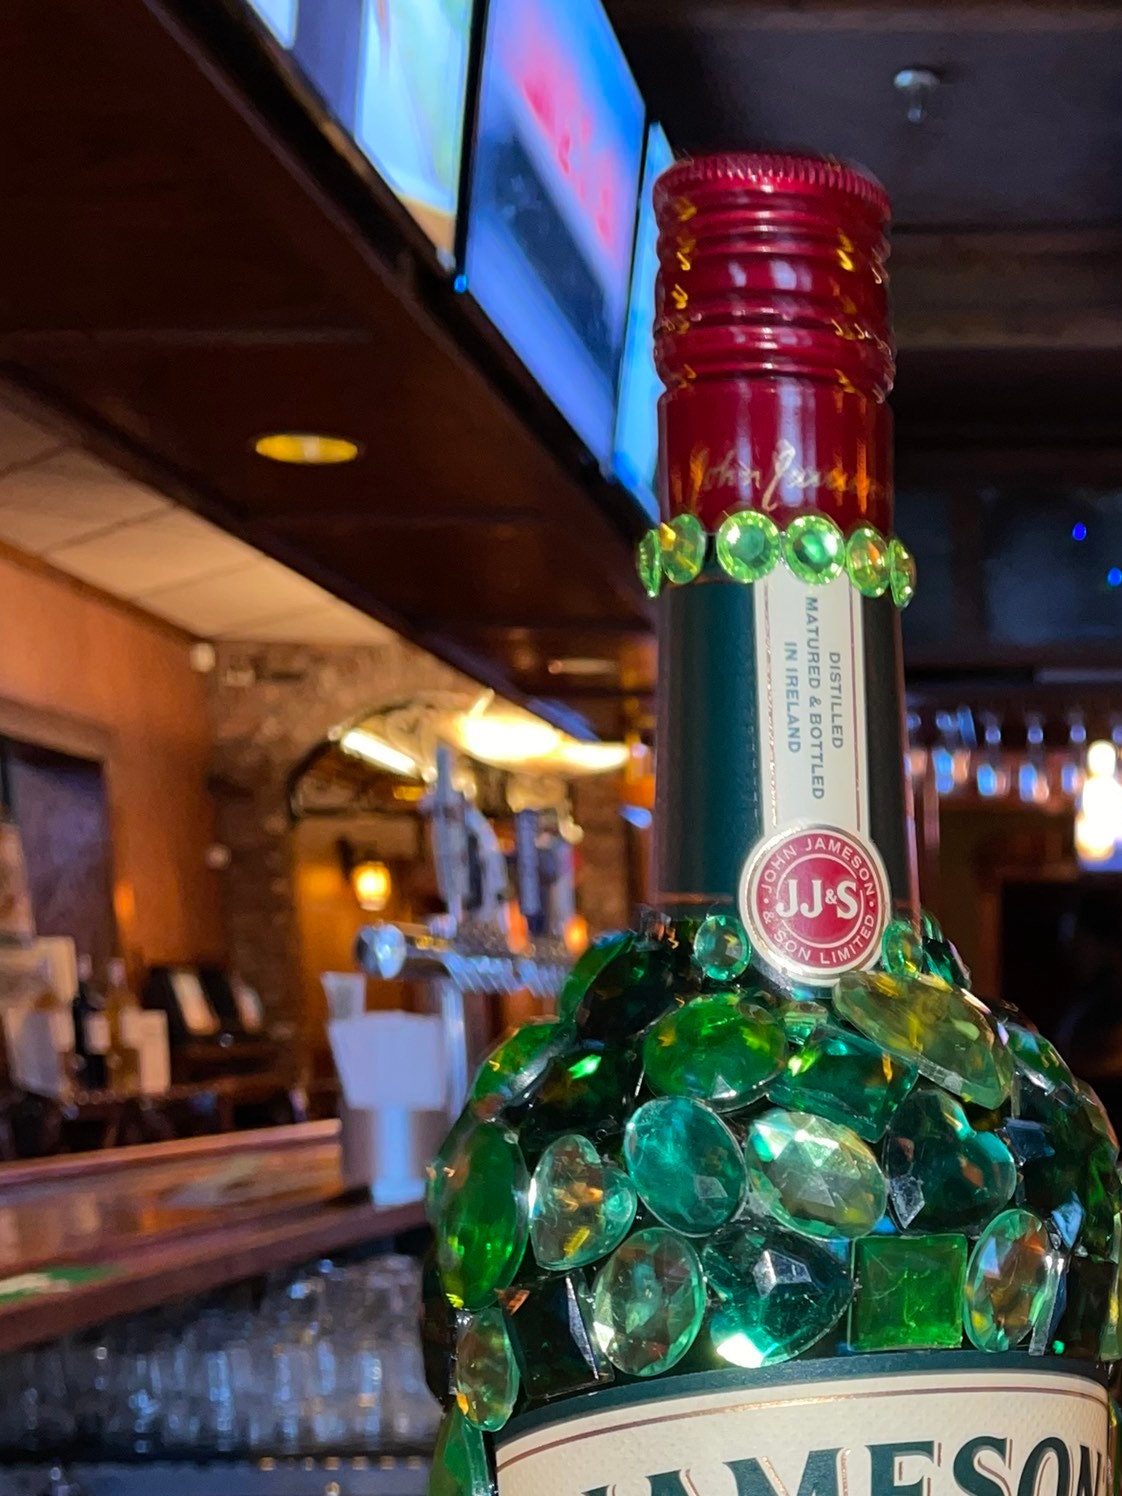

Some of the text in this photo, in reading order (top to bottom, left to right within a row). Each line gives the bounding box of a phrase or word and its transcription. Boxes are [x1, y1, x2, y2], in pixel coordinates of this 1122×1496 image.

[784, 641, 801, 753] IN IRELAND
[806, 596, 825, 800] MATURED & BOTTLED
[829, 651, 844, 749] DISTILLED
[761, 837, 875, 895] JOHN JAMESON
[775, 878, 858, 919] JJ&S
[762, 911, 875, 964] & SON LIMITED
